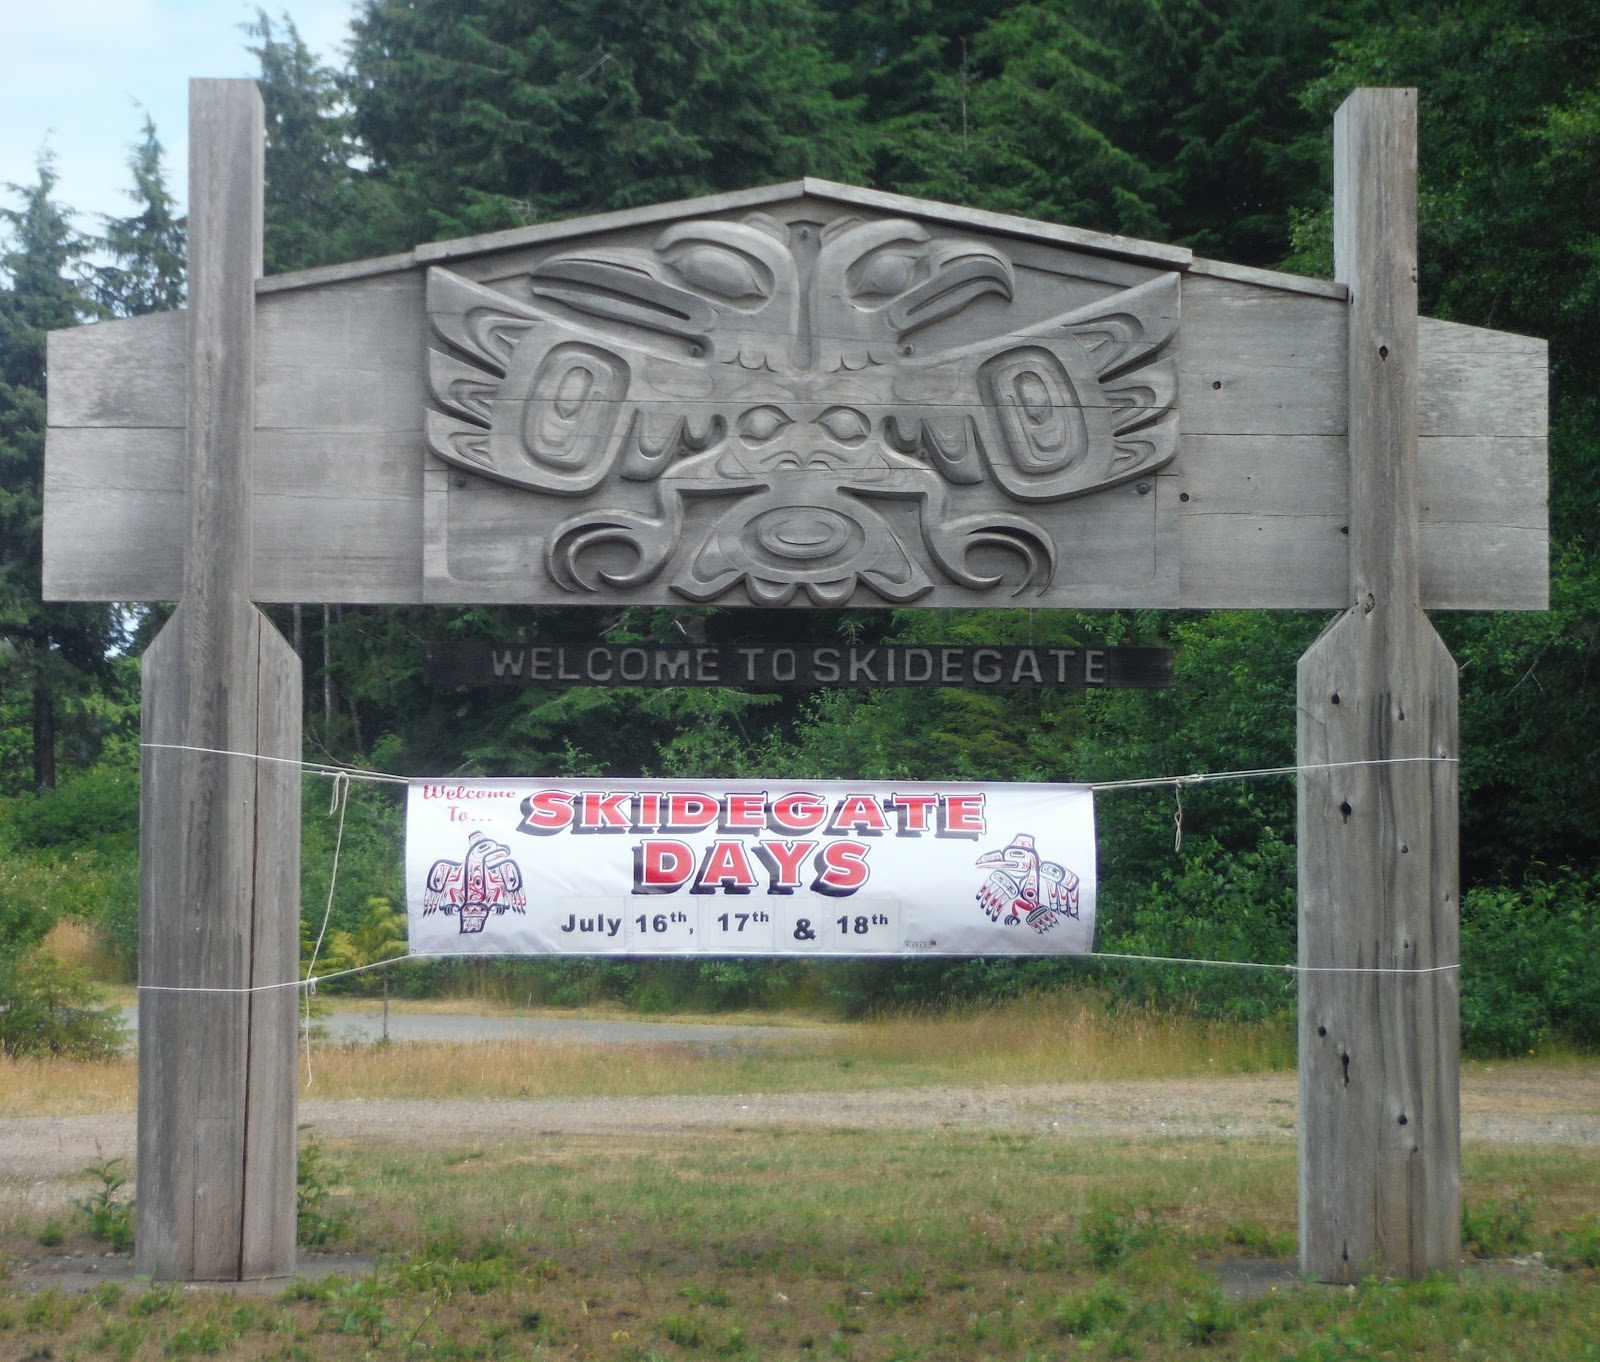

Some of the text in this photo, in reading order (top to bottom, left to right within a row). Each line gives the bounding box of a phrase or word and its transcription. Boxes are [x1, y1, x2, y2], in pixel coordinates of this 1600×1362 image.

[491, 647, 1106, 684] WELCOME TO SKIDEGATE
[423, 784, 517, 800] Welcome
[517, 789, 986, 840] SKIDEGATE
[632, 839, 871, 897] DAYS
[561, 910, 889, 940] July 16th, 17th & 18th
